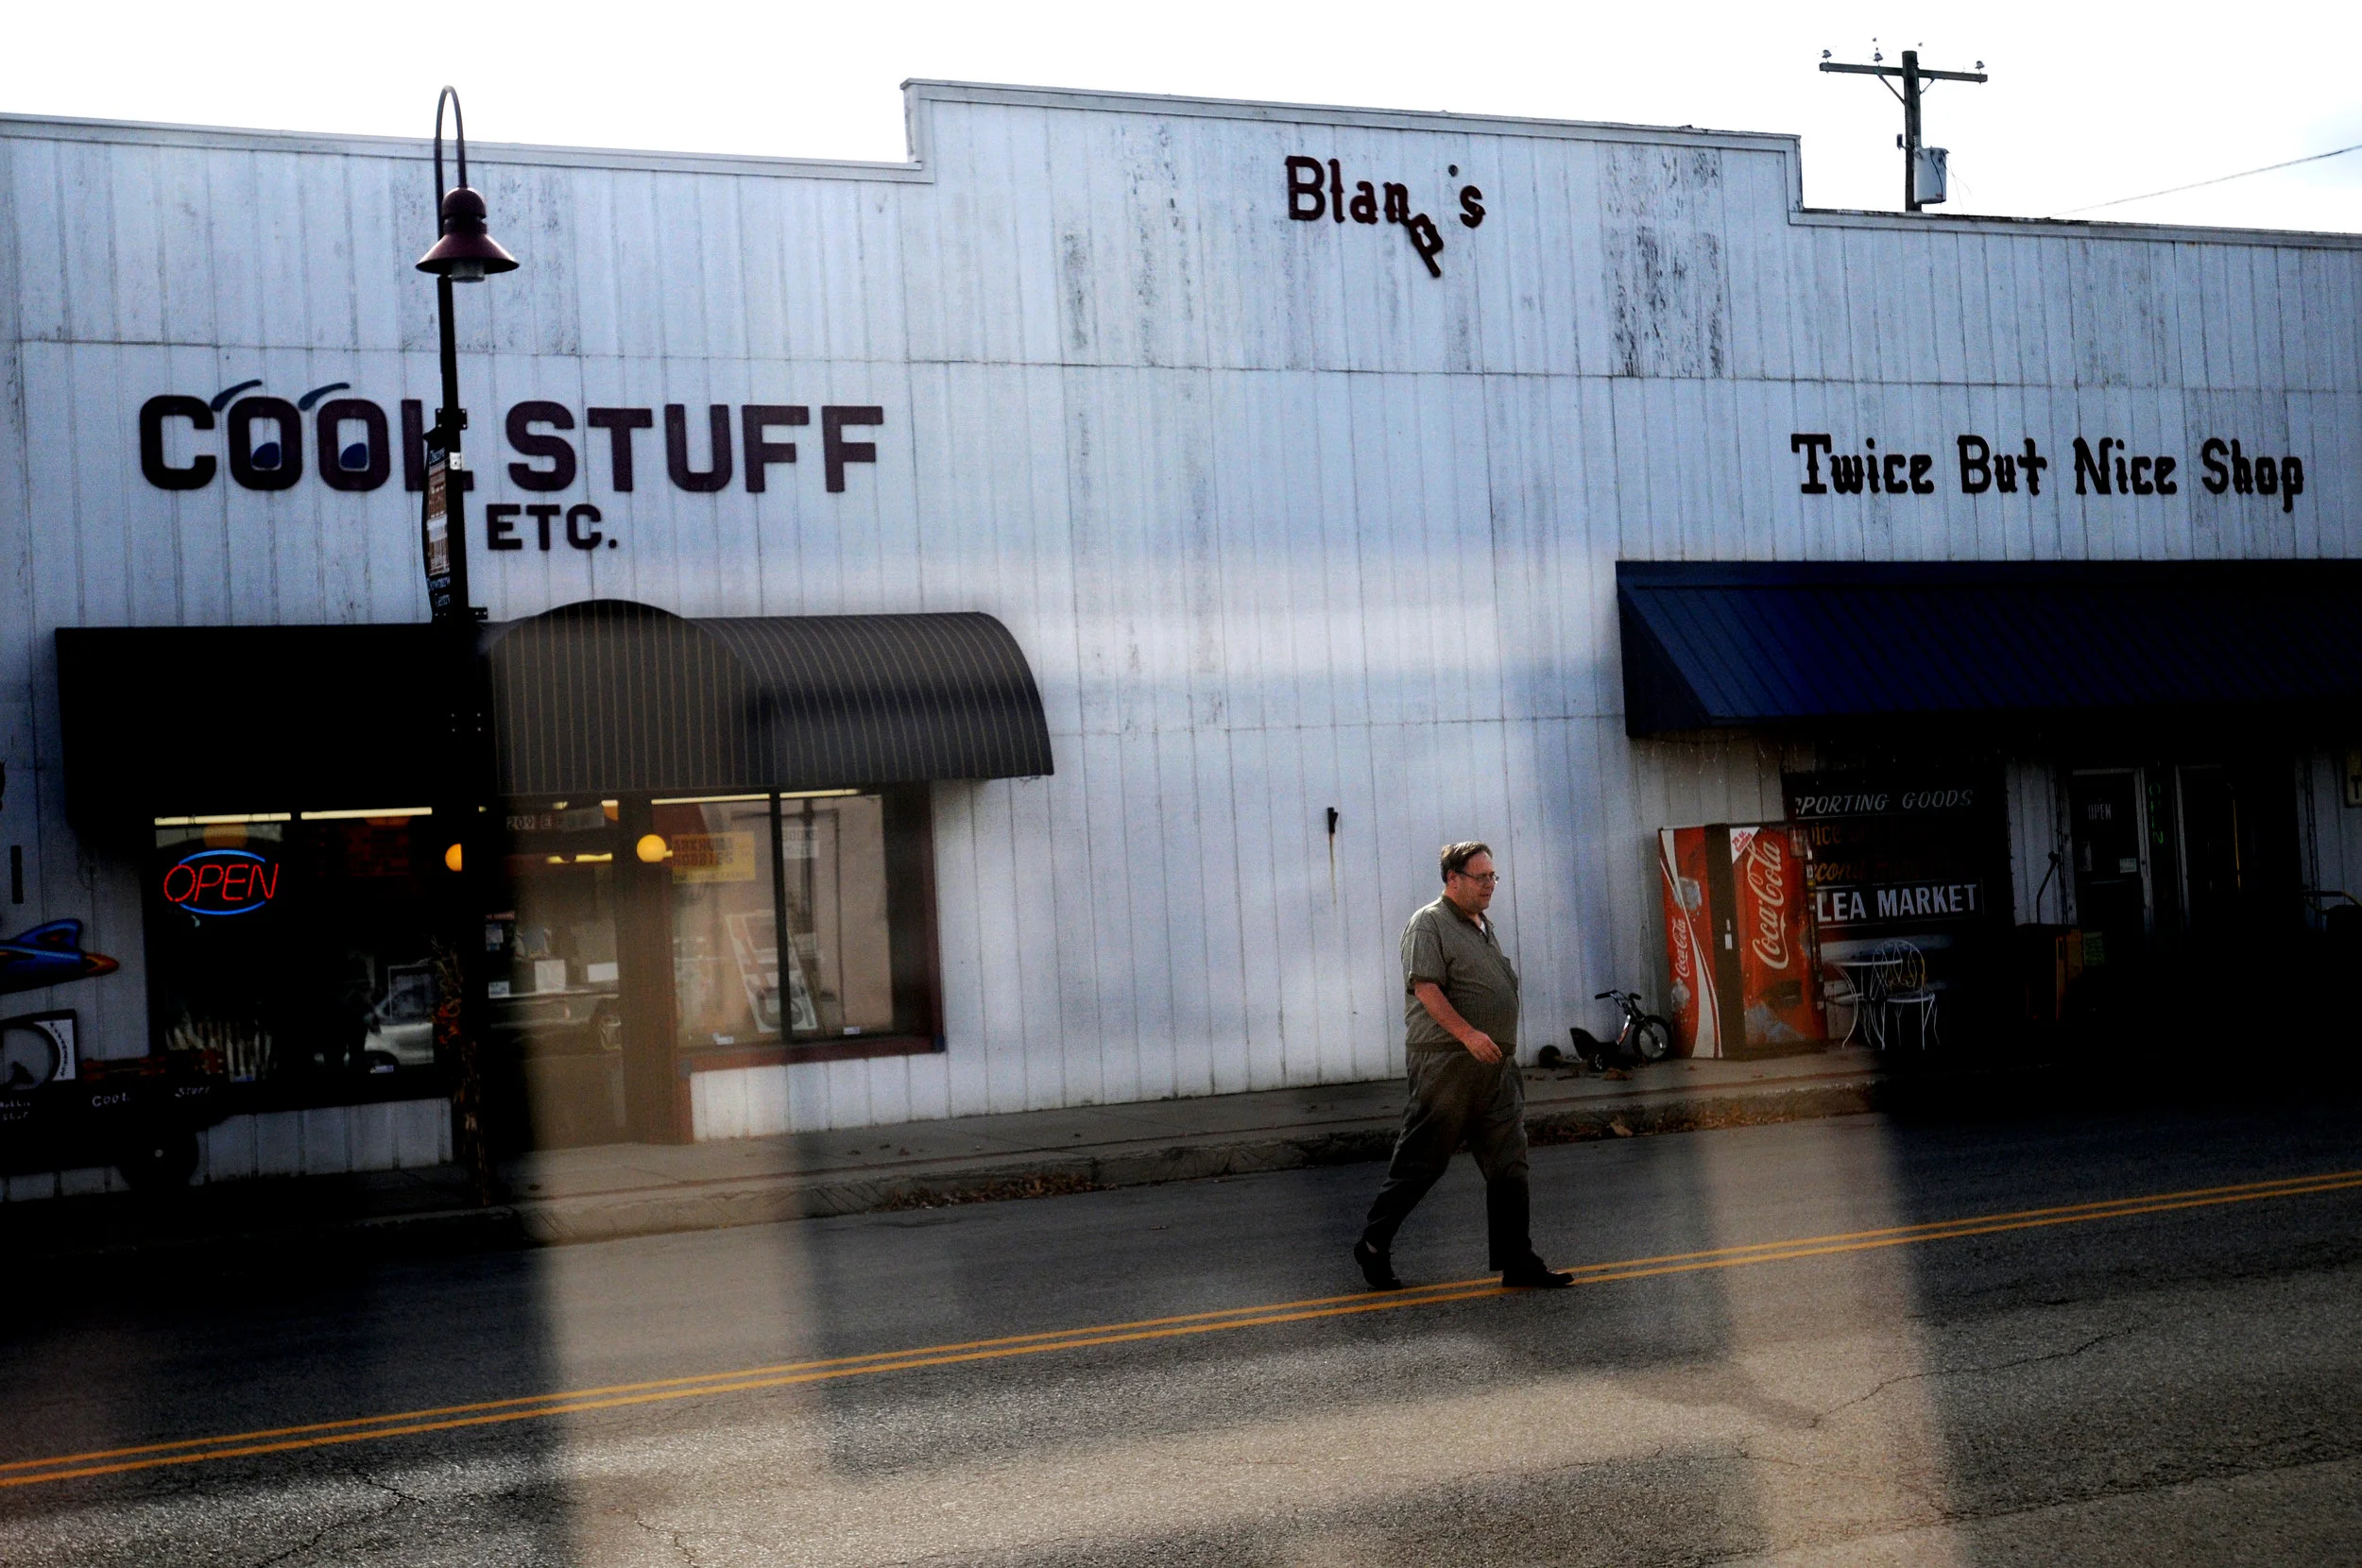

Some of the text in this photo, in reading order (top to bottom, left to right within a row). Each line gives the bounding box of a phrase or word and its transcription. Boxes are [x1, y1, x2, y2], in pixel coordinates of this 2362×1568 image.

[139, 394, 884, 494] COOL STUFF
[1791, 433, 2303, 513] Twice But Nice Shop
[486, 503, 619, 551] ETC.
[1902, 789, 1974, 810] GOODS
[2086, 803, 2113, 821] OPEN
[163, 862, 281, 904] OPEN
[1746, 840, 1789, 970] Coca-Cola
[1816, 883, 1977, 923] LEA MARKET
